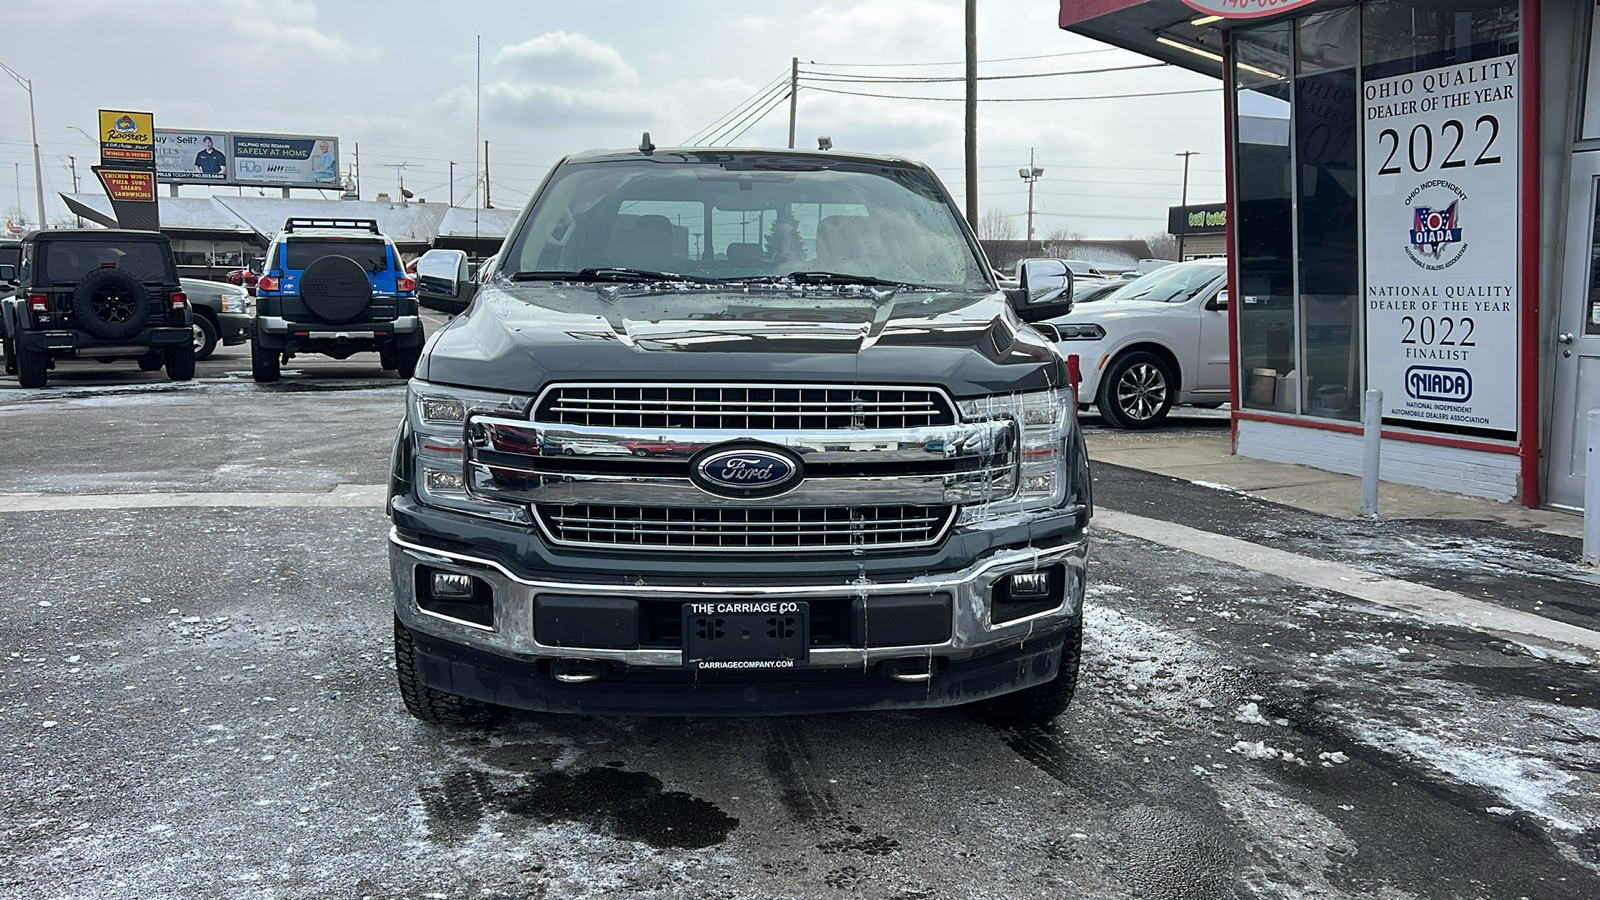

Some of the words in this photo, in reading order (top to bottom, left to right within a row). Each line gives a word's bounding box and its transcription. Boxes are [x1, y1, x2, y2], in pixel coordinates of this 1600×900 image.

[1366, 78, 1413, 100] OHIO
[1423, 59, 1517, 93] QUALITY
[1367, 100, 1417, 120] DEALER
[1421, 97, 1439, 112] OF
[1442, 92, 1470, 109] THE
[1474, 85, 1514, 104] YEAR
[107, 129, 148, 142] Roosters
[154, 136, 167, 144] uy
[176, 136, 198, 144] Sell?
[237, 147, 267, 155] SAFELY
[1377, 115, 1502, 175] 2022
[1404, 187, 1420, 206] OHIO
[1420, 179, 1468, 202] INDEPENDENT
[1415, 230, 1453, 244] OIADA
[1403, 245, 1426, 269] AUTOMOBILE
[1425, 263, 1445, 271] DEALERS
[1444, 242, 1469, 269] ASSOCIATION
[1369, 286, 1439, 297] NATIONAL
[1446, 286, 1513, 298] QUALITY
[1370, 301, 1416, 311] DEALER
[1422, 301, 1438, 311] OF
[1443, 301, 1469, 312] THE
[1475, 302, 1511, 312] YEAR
[1401, 316, 1476, 347] 2022
[1406, 348, 1469, 361] FINALIST
[1410, 373, 1466, 396] NIADA
[1406, 402, 1432, 410] NATIONAL
[1433, 404, 1472, 414] INDEPENDENT
[1391, 408, 1424, 418] AUTOMOBILE
[1425, 412, 1449, 420] DEALERS
[1450, 414, 1490, 425] ASSOCIATION
[721, 458, 774, 480] Ford
[691, 603, 715, 613] THE
[717, 603, 778, 613] CARRIAGE
[779, 602, 800, 613] CO.
[698, 660, 794, 669] CARRIAGECOMPANY.COM
